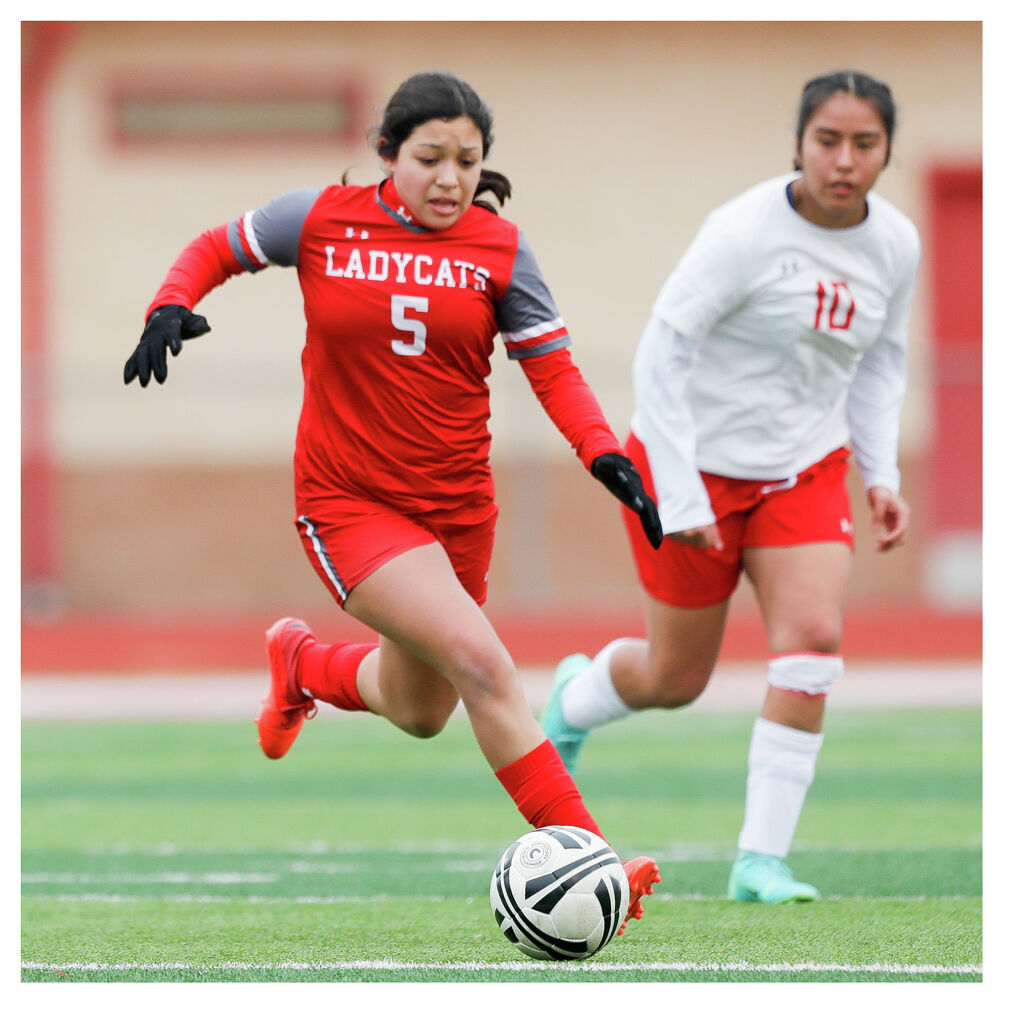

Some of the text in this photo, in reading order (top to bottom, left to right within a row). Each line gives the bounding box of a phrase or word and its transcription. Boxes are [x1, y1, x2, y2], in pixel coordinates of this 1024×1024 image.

[324, 245, 490, 291] LADYCATS
[390, 294, 429, 357] 5
[814, 280, 855, 331] 10
